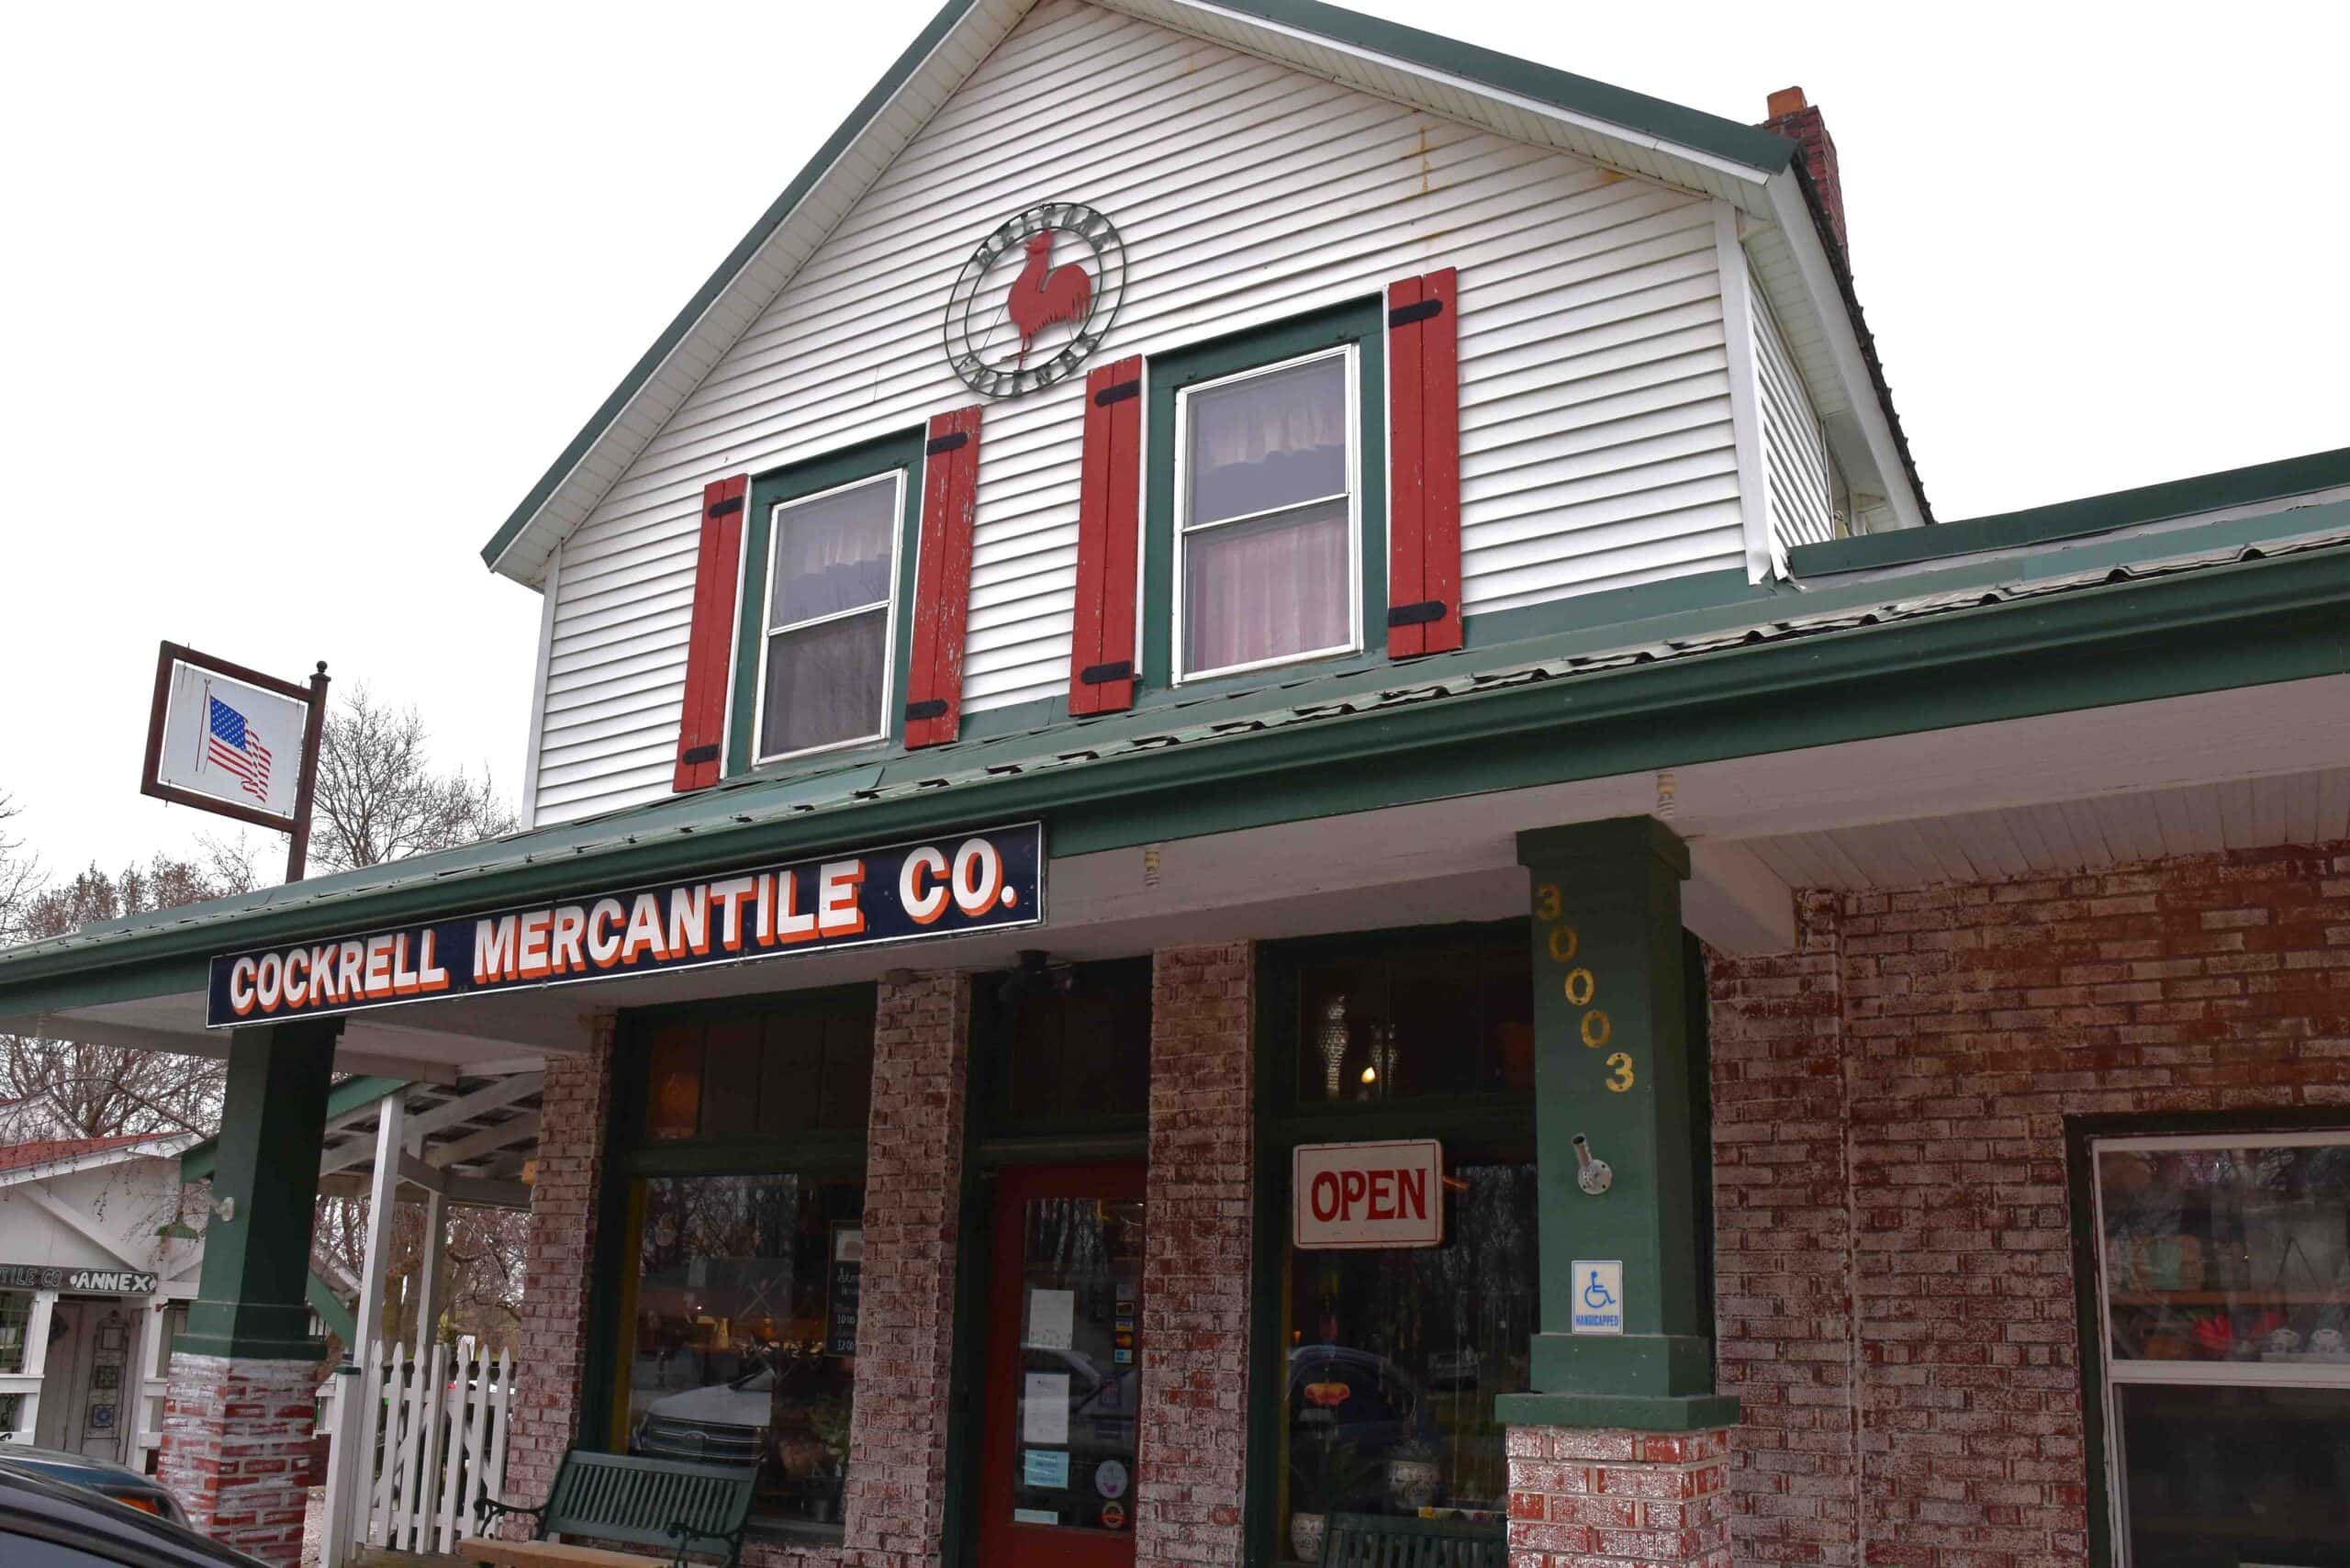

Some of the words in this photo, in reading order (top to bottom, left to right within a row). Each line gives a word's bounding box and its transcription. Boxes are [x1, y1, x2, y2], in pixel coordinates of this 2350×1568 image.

[229, 927, 451, 1017] COCKRELL
[472, 858, 866, 984] MERCANTILE
[898, 837, 1018, 925] CO.
[1311, 1168, 1427, 1223] OPEN
[75, 1271, 150, 1293] ANNEX
[1575, 1314, 1619, 1327] HANDICAPPED
